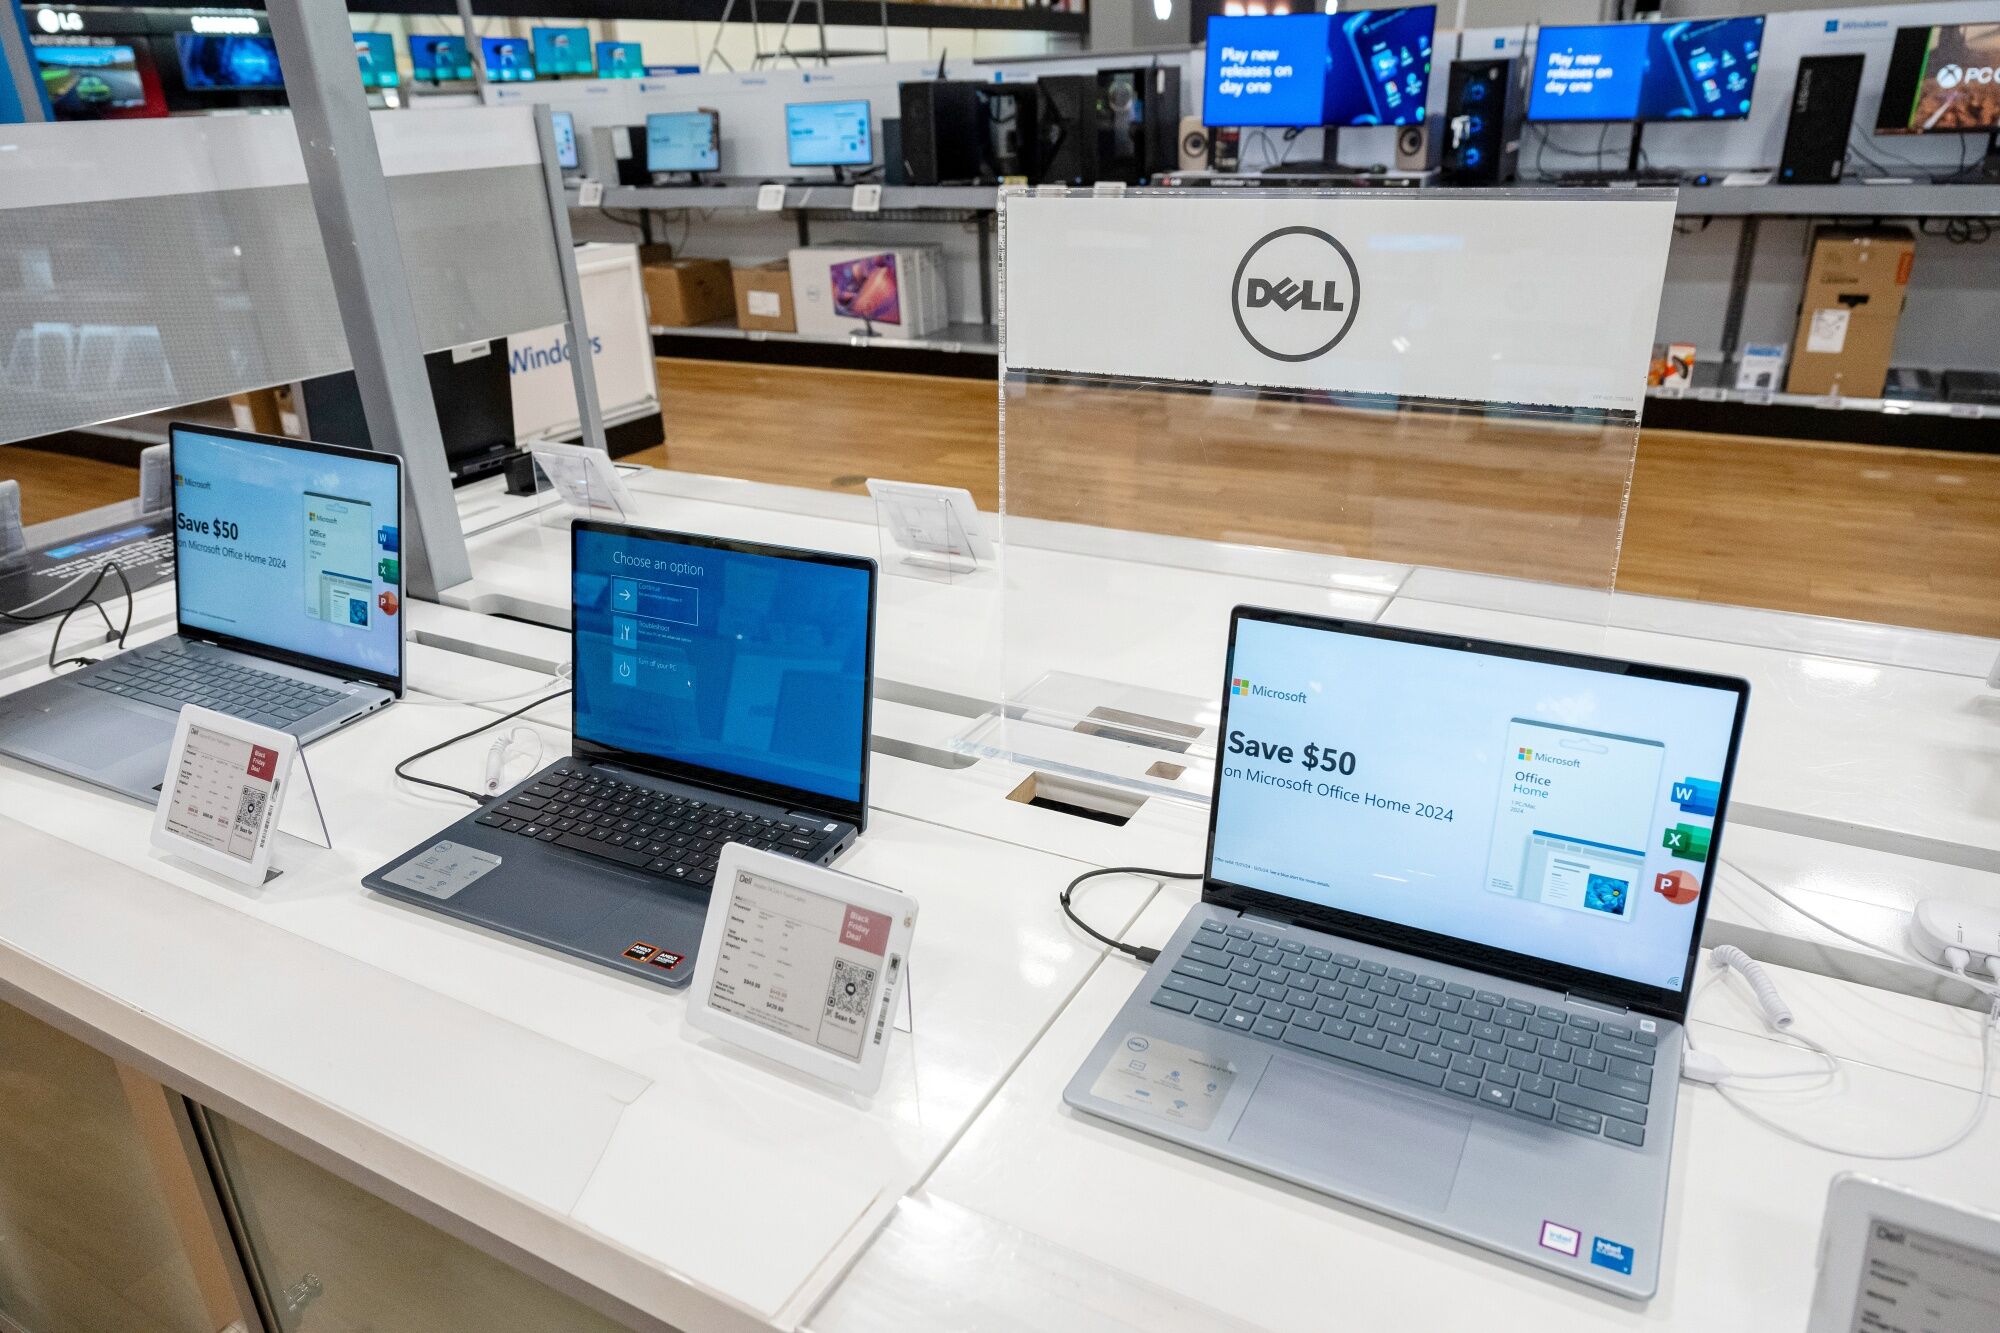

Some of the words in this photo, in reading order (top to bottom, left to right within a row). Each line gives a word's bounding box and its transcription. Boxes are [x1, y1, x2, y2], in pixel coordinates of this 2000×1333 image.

[57, 13, 84, 31] LG
[1222, 46, 1248, 65] Play
[1251, 50, 1280, 62] new
[1548, 52, 1574, 70] Play
[1575, 54, 1602, 66] new
[1220, 63, 1272, 78] releases
[1274, 65, 1292, 78] on
[1547, 66, 1594, 79] releases
[1596, 68, 1613, 79] on
[1964, 67, 1994, 85] PC
[1219, 79, 1244, 98] day
[1246, 82, 1272, 94] one
[1545, 79, 1568, 96] day
[1568, 82, 1593, 93] one
[1246, 276, 1344, 312] DELL
[184, 478, 210, 490] Microsoft
[178, 512, 209, 534] Save
[213, 518, 238, 540] $50
[309, 528, 326, 540] Office
[188, 540, 220, 554] Microsoft
[222, 546, 242, 560] Office
[244, 552, 266, 565] Home
[268, 556, 286, 568] 2024
[613, 552, 651, 568] Choose
[654, 560, 666, 570] an
[670, 562, 704, 576] option
[1252, 684, 1307, 704] Microsoft
[254, 750, 266, 758] Black
[1228, 730, 1294, 764] Save
[1301, 742, 1356, 776] $50
[1534, 752, 1580, 768] Microsoft
[250, 764, 260, 773] Deal
[253, 758, 266, 767] Friday
[1515, 772, 1552, 786] Office
[1224, 766, 1242, 778] on
[1246, 768, 1313, 794] Microsoft
[1317, 782, 1360, 802] Office
[1365, 792, 1410, 814] Home
[1415, 803, 1454, 822] 2024
[1513, 784, 1549, 798] Home
[1676, 786, 1692, 800] W
[1668, 832, 1682, 847] X
[739, 874, 752, 885] Dell
[1660, 878, 1672, 890] P
[850, 912, 869, 922] Black
[846, 930, 862, 941] Deal
[848, 921, 870, 936] Friday
[834, 1012, 848, 1022] Scan
[848, 1016, 856, 1024] for
